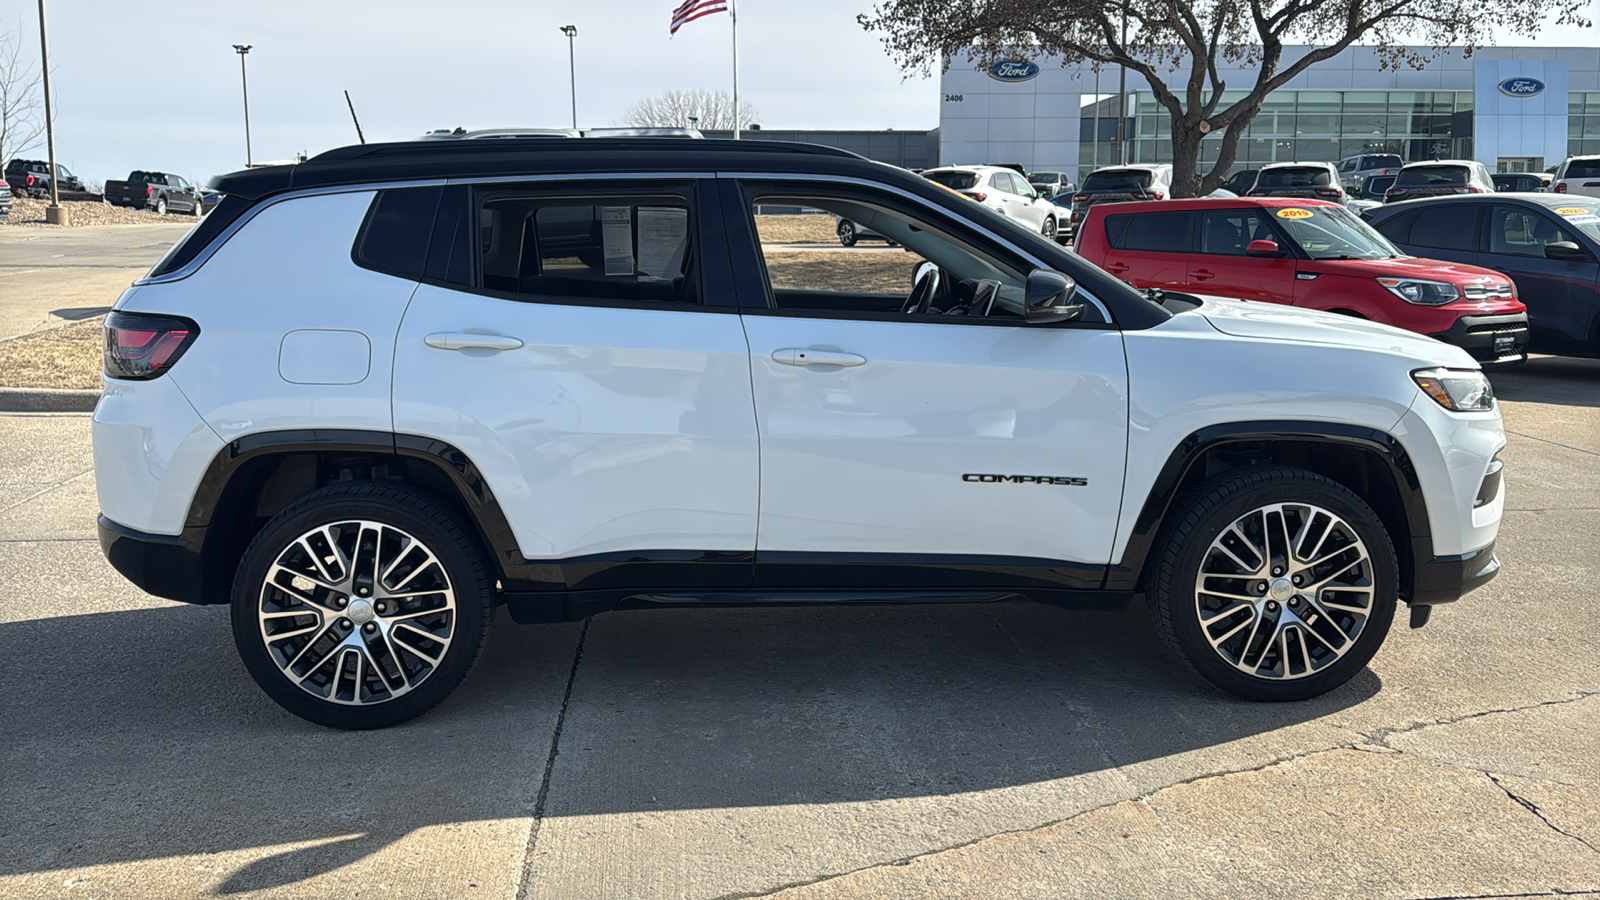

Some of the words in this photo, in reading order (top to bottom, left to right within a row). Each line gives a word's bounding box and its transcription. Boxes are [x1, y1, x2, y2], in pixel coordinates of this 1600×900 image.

[998, 62, 1029, 77] Ford
[1511, 81, 1537, 92] Ford
[945, 94, 964, 102] 2406
[962, 473, 1088, 486] COMPASS
